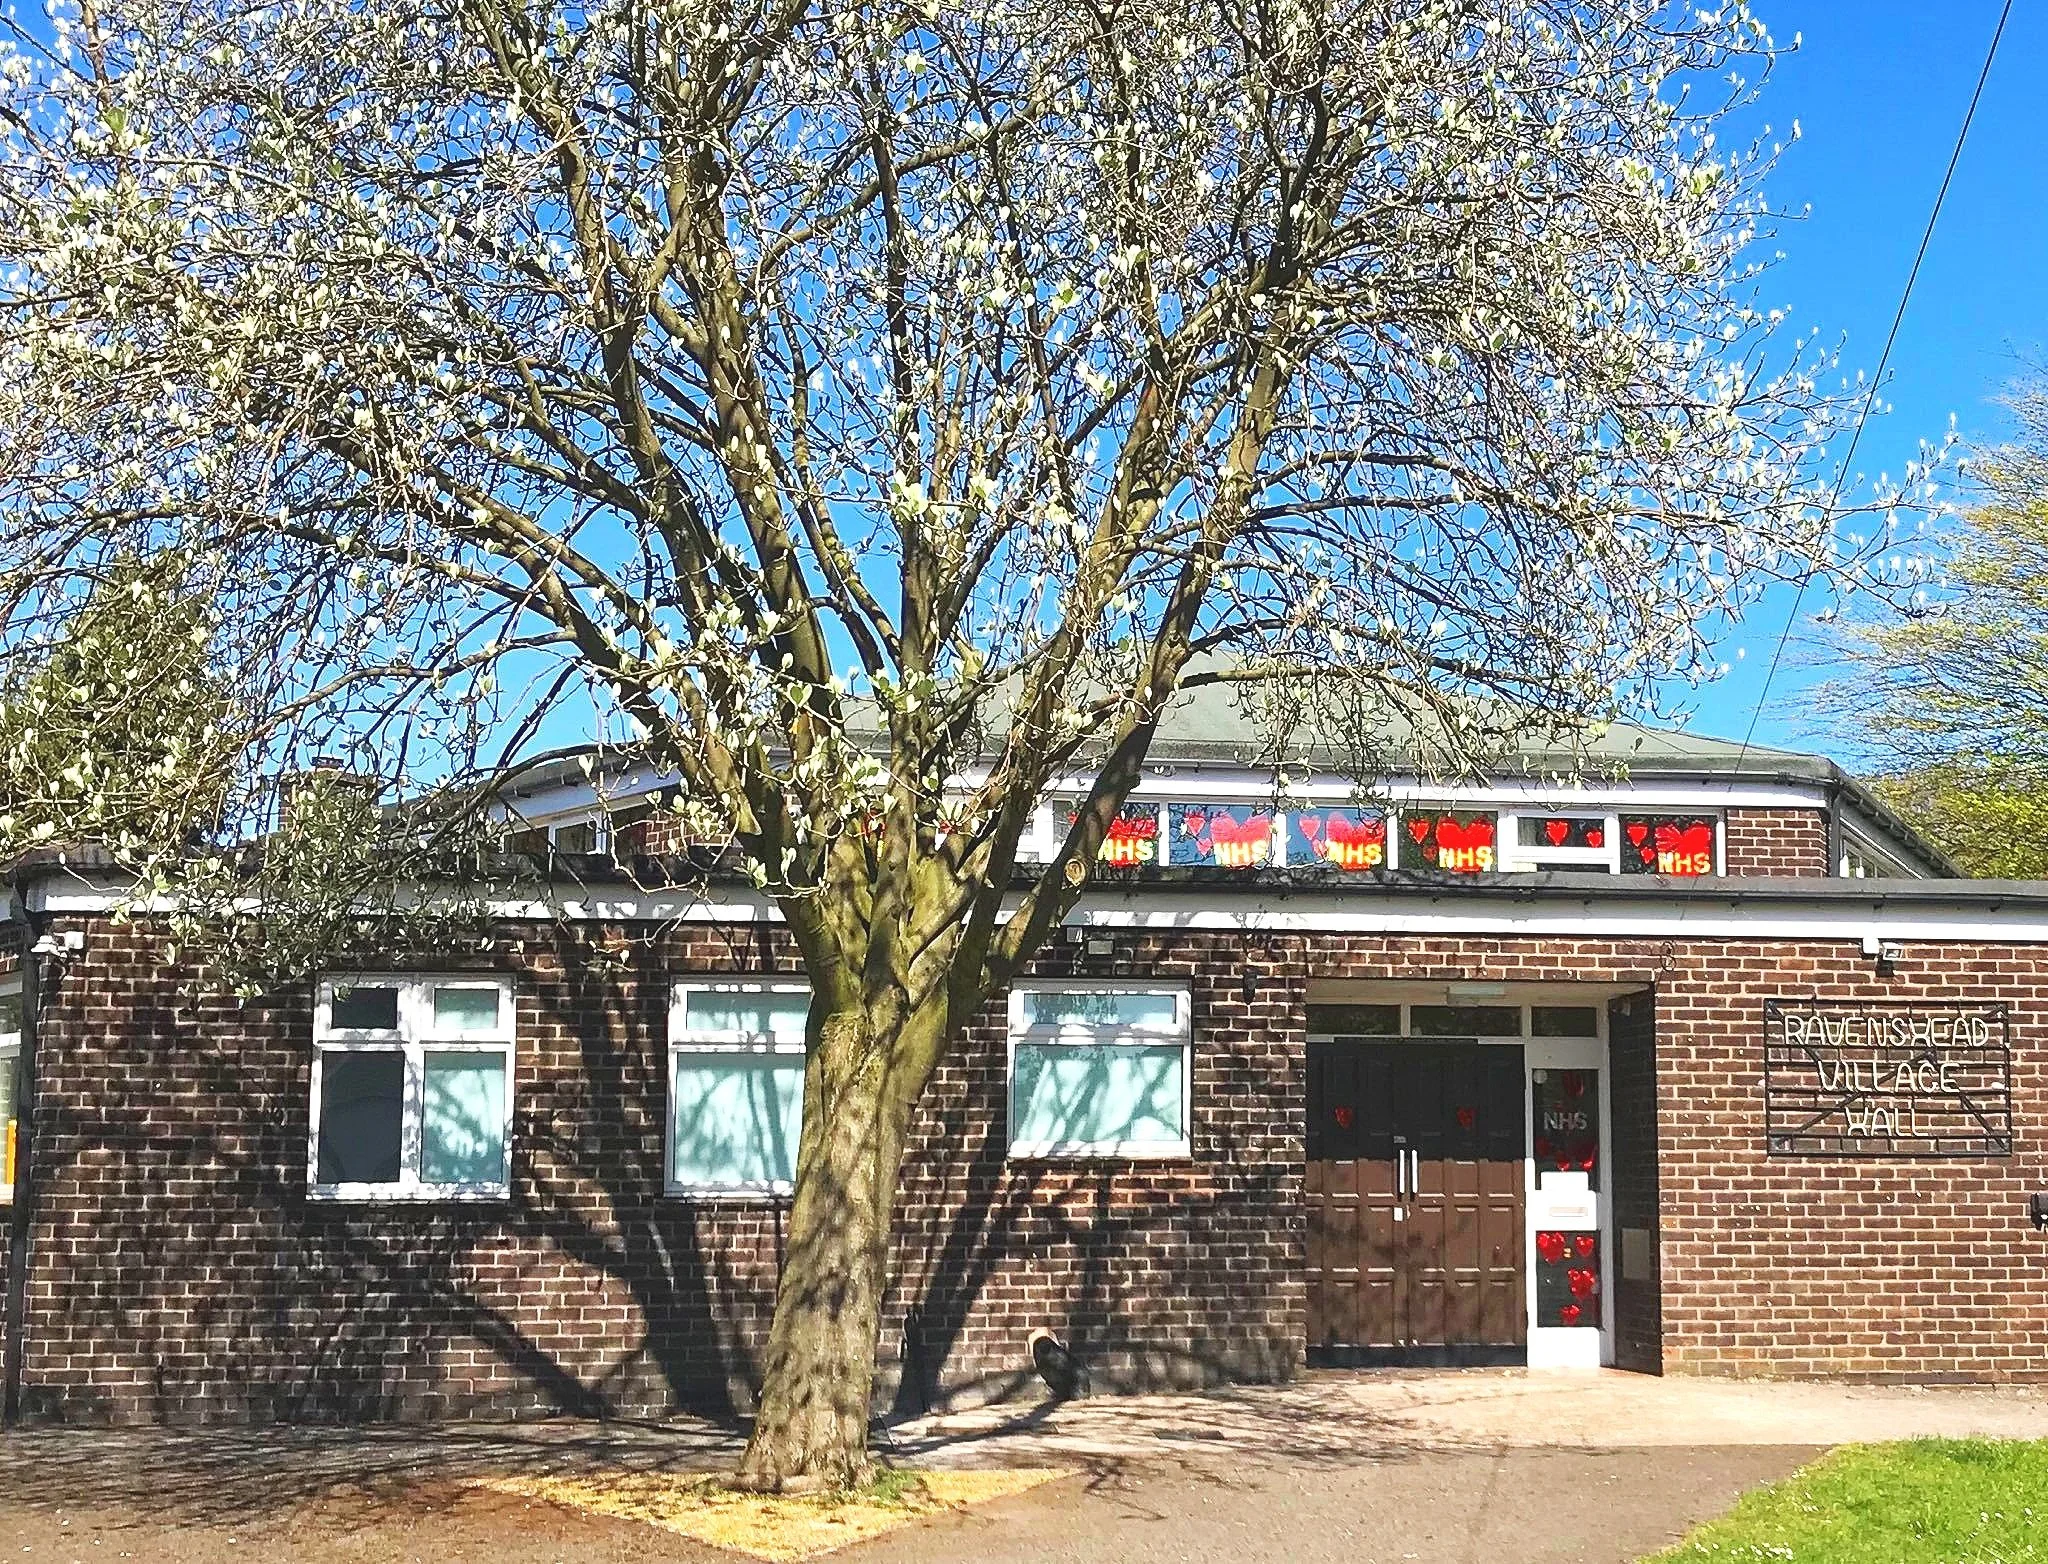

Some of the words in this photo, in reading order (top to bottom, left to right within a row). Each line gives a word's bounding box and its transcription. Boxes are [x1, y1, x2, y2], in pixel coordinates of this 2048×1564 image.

[1098, 838, 1153, 861] NHS
[1214, 840, 1268, 865] NHS
[1328, 841, 1382, 864] NHS
[1438, 846, 1494, 870] NHS
[1658, 852, 1710, 874] NHS
[1784, 1014, 1989, 1047] RAVENSHEAD
[1817, 1060, 1960, 1093] VILLAGE
[1544, 1112, 1587, 1130] NHS
[1845, 1106, 1929, 1137] HALL
